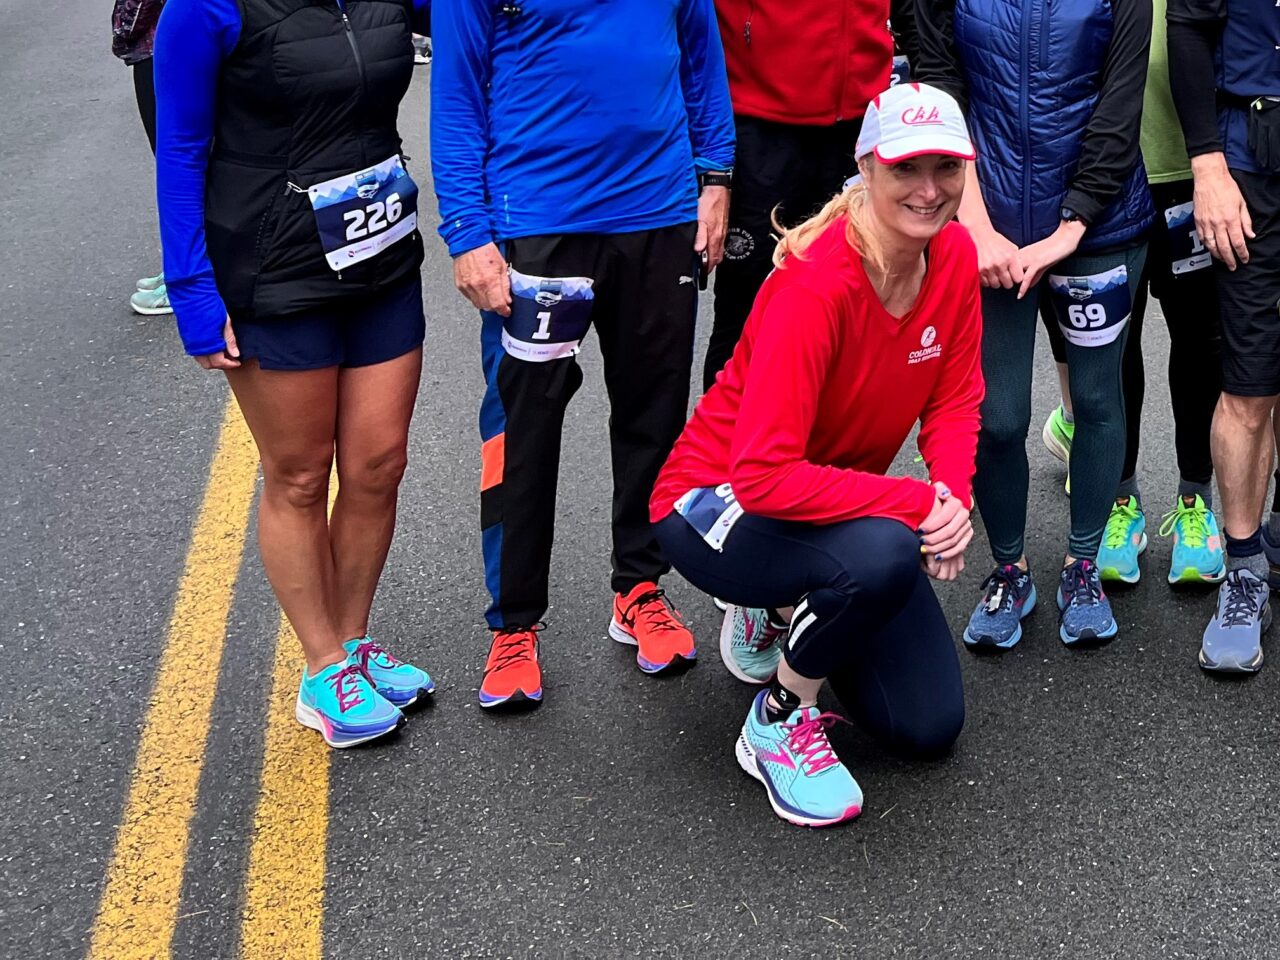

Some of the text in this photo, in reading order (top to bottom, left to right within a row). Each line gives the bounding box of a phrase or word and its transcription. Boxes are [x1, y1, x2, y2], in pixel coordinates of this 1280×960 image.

[343, 192, 403, 241] 226
[531, 311, 552, 340] 1
[1068, 303, 1107, 329] 69
